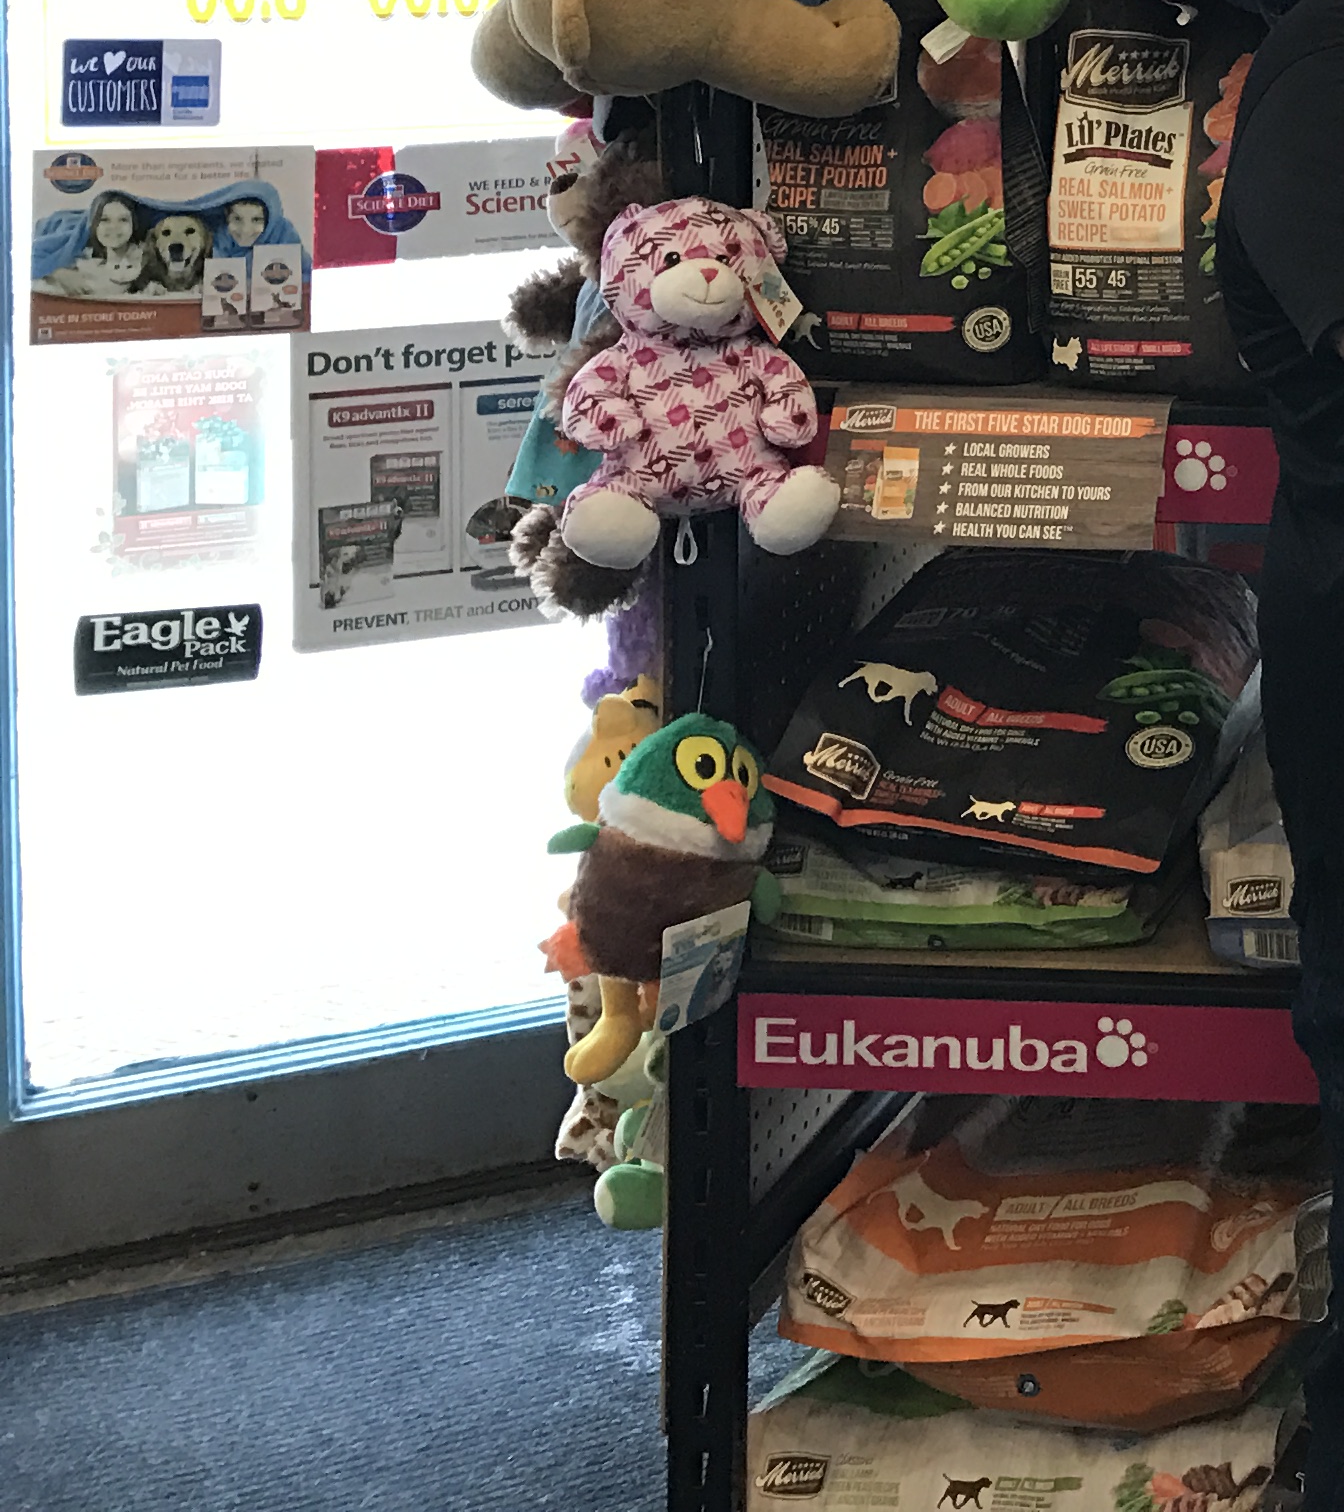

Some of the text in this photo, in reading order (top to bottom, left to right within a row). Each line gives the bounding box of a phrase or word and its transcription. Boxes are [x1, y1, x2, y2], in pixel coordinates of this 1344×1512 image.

[68, 79, 158, 113] CUSTOMERS
[1105, 120, 1176, 155] Plates
[469, 177, 539, 191] WE FEED &
[1058, 177, 1163, 201] REAL SALMON
[465, 191, 549, 215] Scienc
[1058, 199, 1166, 223] SWEET POTATO
[1057, 222, 1108, 243] RECIPE
[308, 341, 497, 377] Don't forget
[332, 403, 429, 423] K9 advantix II
[914, 411, 1132, 437] THE FIRST FIVE STAR DOG FOOD
[963, 442, 1050, 459] LOCAL GROWERS
[960, 462, 1064, 480] REAL WHOLE FOODS
[958, 483, 1112, 501] FROM OUR KITCHEN TO YOURS
[955, 502, 1070, 520] BALANCED NUTRITION
[952, 522, 1040, 539] HEALTH YOU CAN
[332, 601, 495, 633] PREVENT, TREAT and
[90, 610, 221, 653] Eagle
[183, 638, 248, 658] Pack
[116, 657, 223, 676] Natural Pet Food
[1143, 738, 1179, 756] USA
[753, 1015, 1089, 1075] Eukanuba
